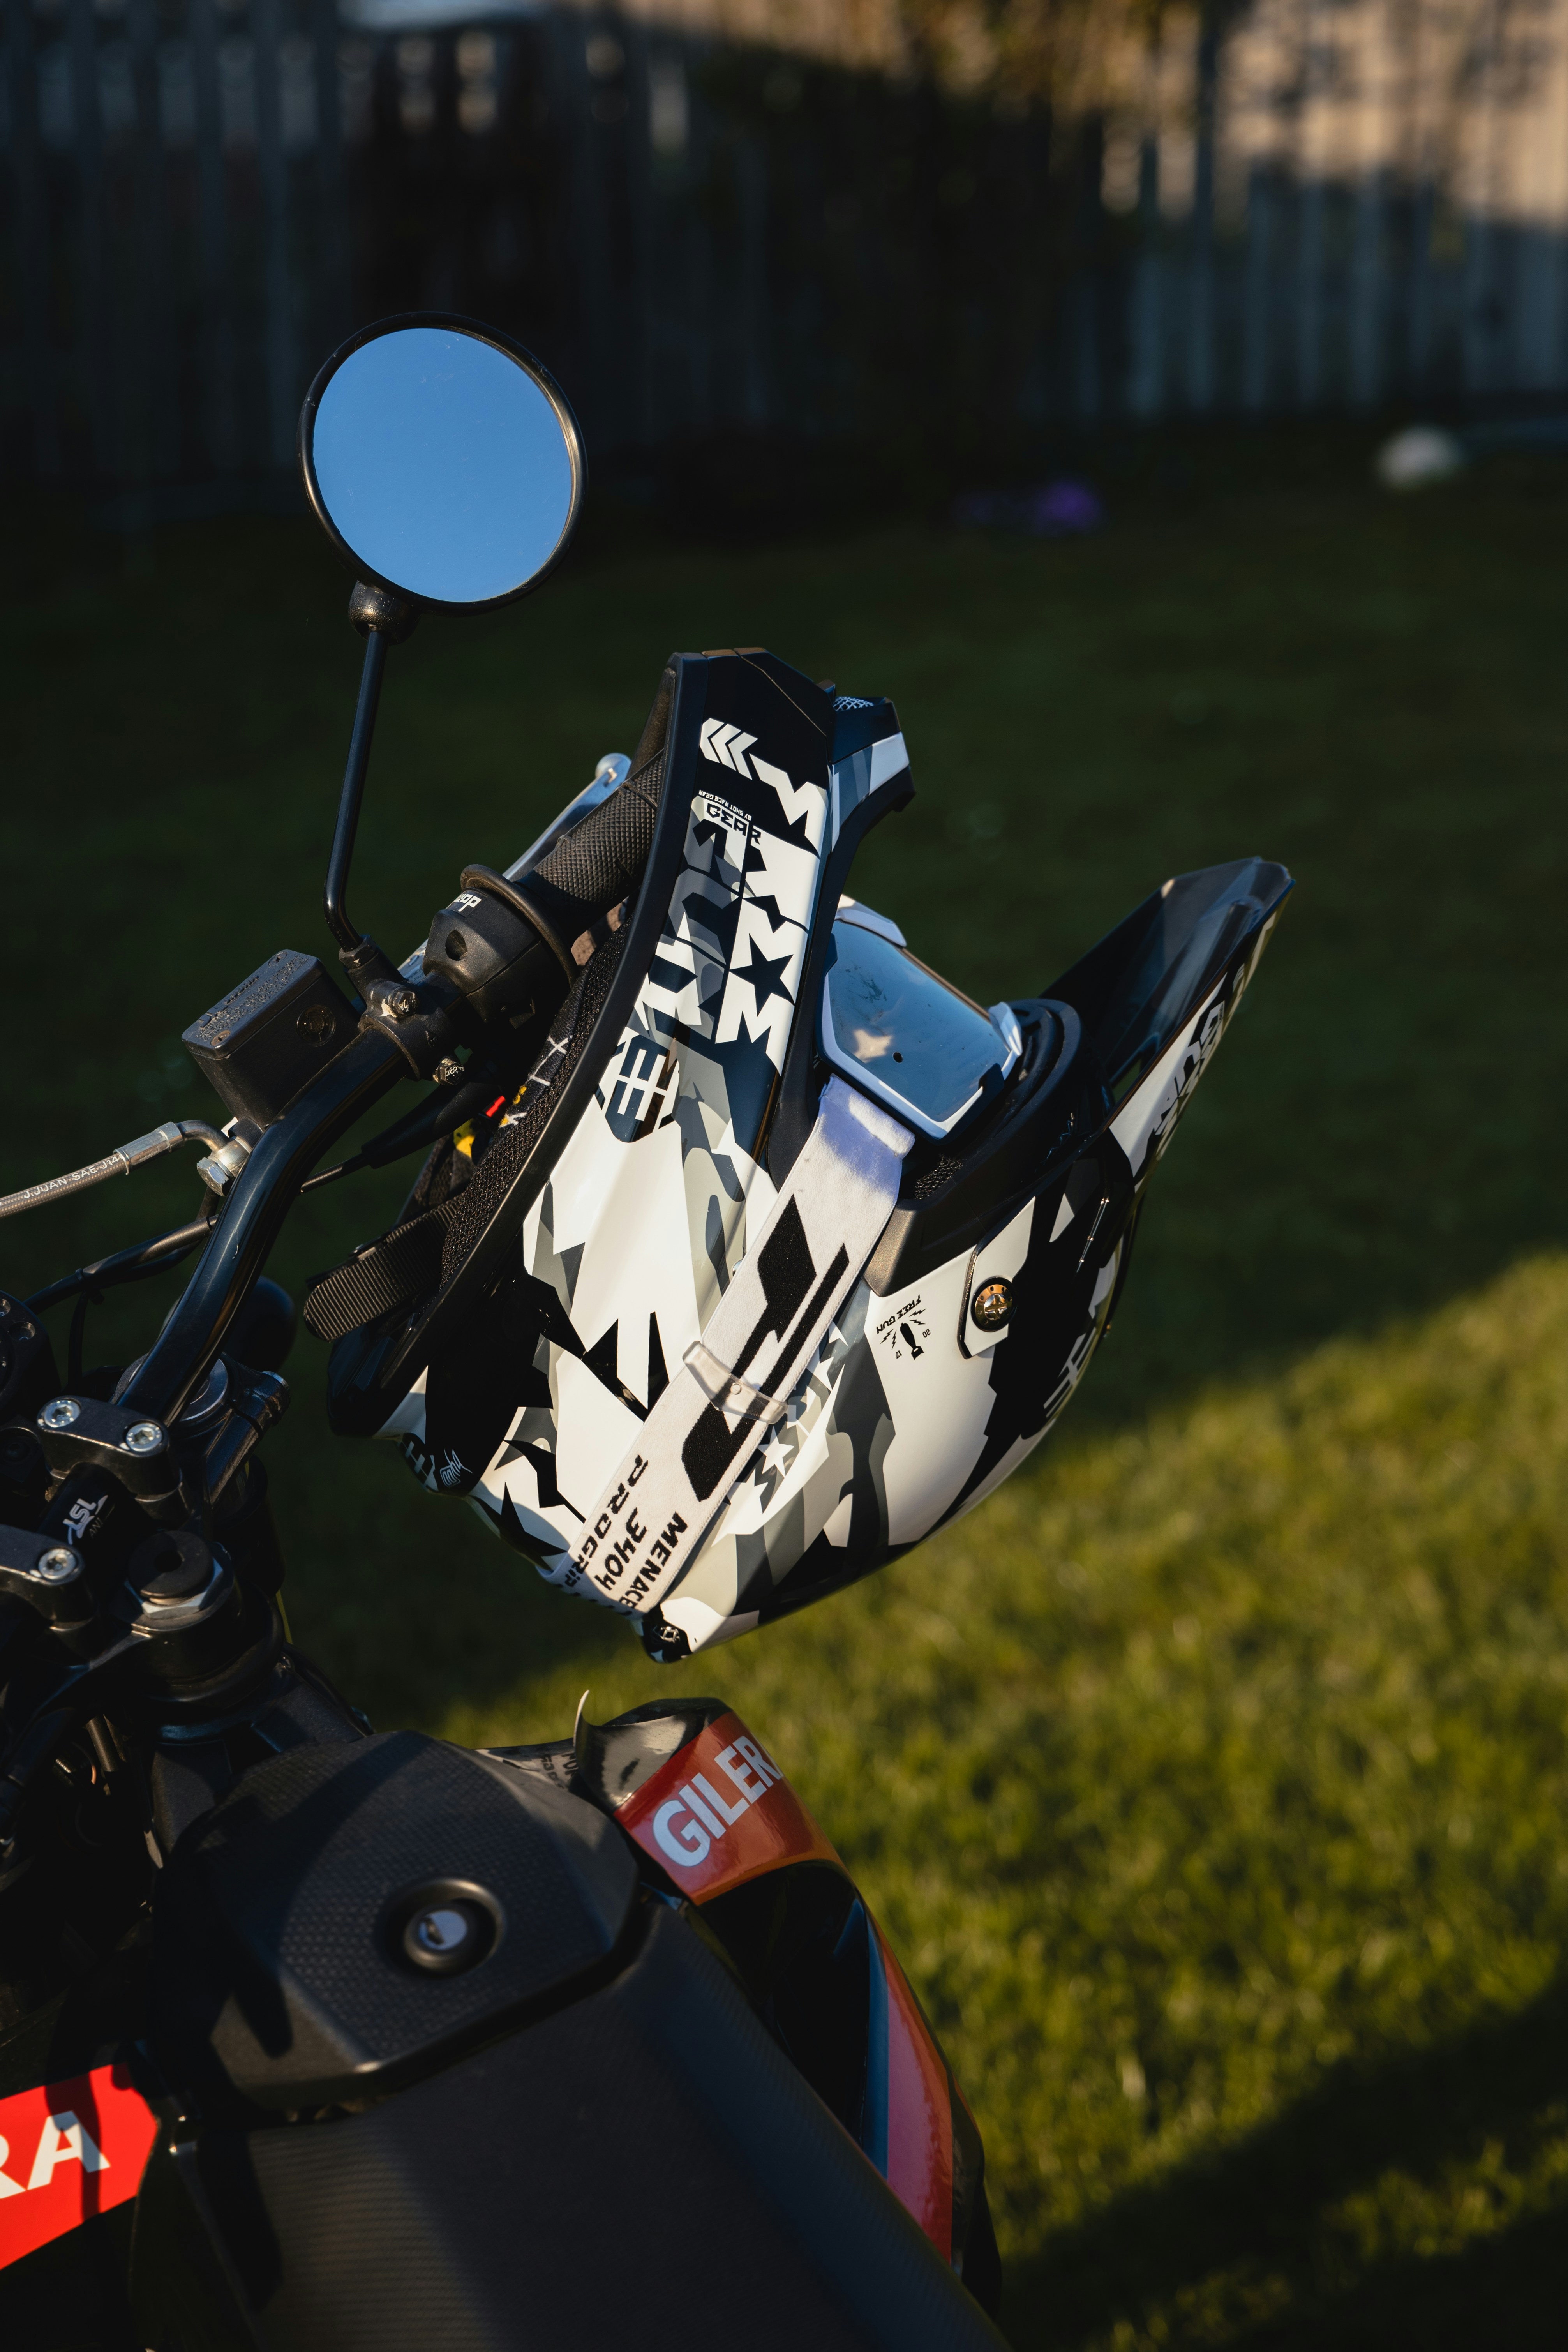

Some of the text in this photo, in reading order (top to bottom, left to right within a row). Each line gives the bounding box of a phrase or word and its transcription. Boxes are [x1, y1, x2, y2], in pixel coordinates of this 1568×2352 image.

[698, 789, 714, 800] GEAR
[714, 796, 729, 807] RACE
[729, 804, 744, 817] SHOT
[706, 803, 762, 845] GEAR
[23, 1177, 67, 1199] J.JUAN
[72, 1166, 98, 1181] SAE
[876, 1294, 921, 1334] FREE GUN
[922, 1328, 931, 1338] 20
[896, 1350, 902, 1359] 17
[62, 1498, 97, 1531] LSL
[594, 1507, 647, 1591] 3404
[619, 1511, 688, 1609] MENACE
[653, 1736, 783, 1867] GILER
